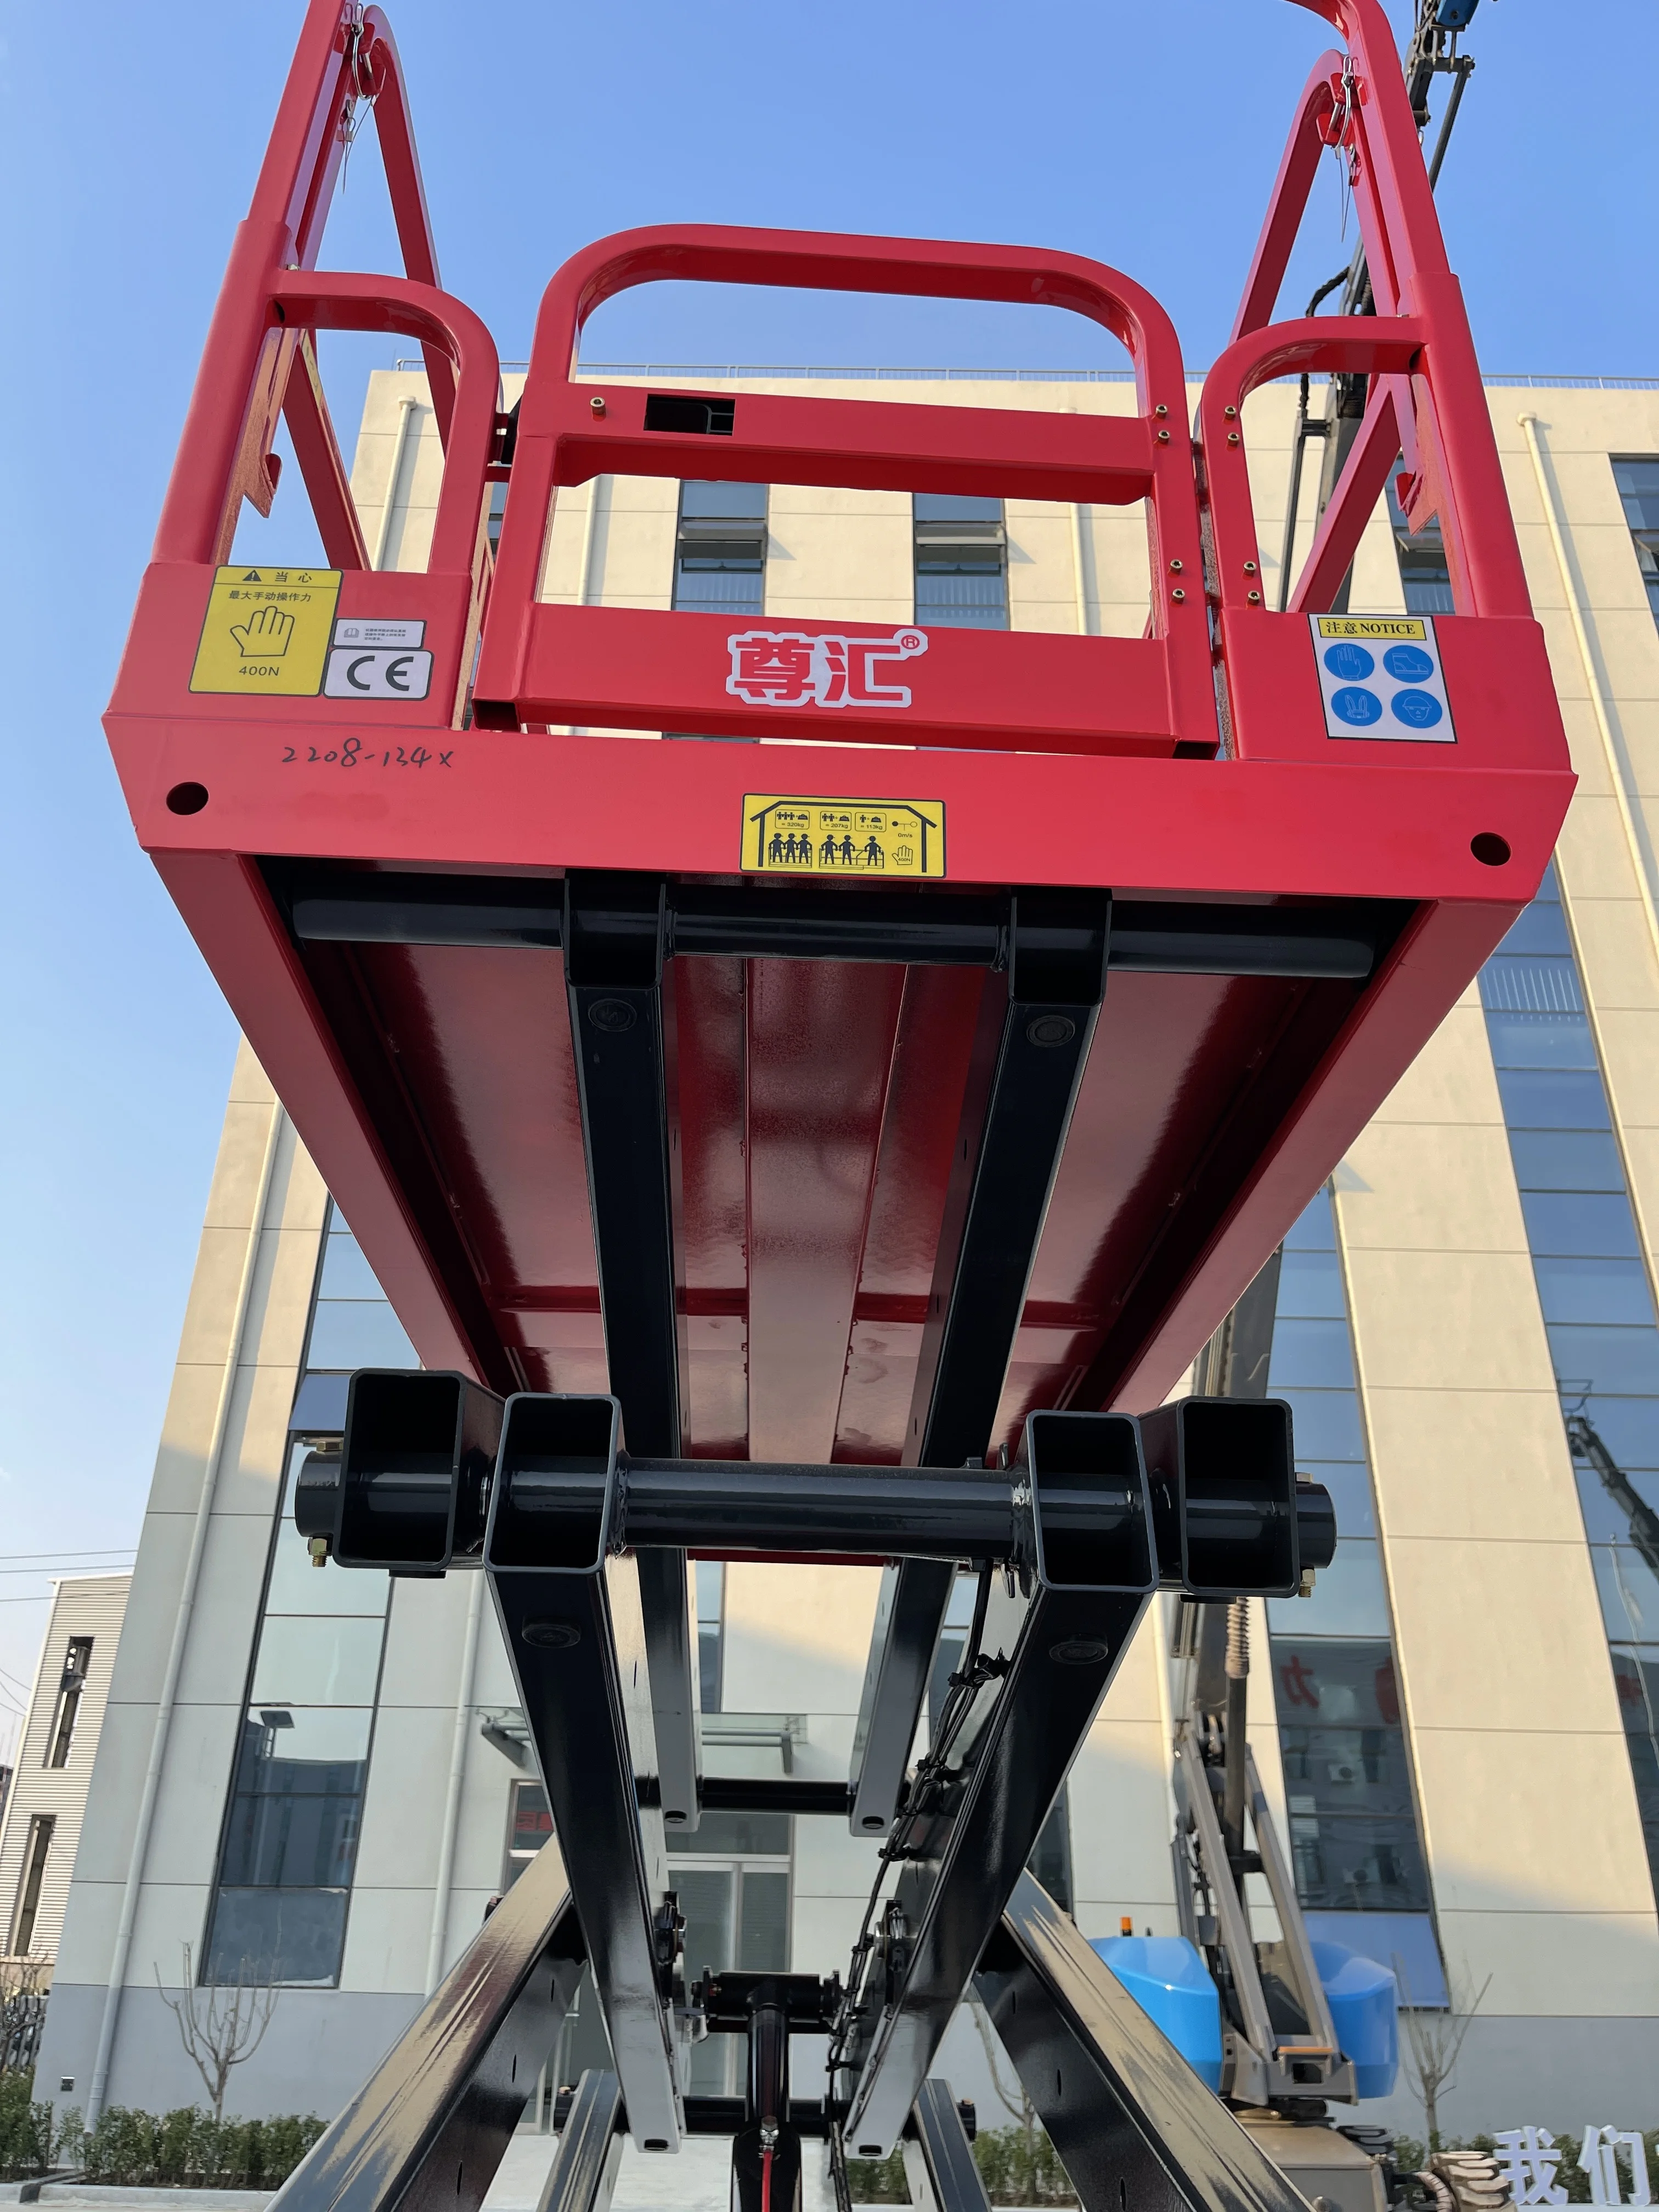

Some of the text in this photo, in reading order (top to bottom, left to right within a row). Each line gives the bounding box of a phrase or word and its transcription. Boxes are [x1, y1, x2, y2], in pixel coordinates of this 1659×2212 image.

[275, 571, 313, 583] 当心
[228, 590, 312, 602] 最大手动操作力
[1325, 621, 1416, 635] 注意 NOTICE
[239, 665, 280, 677] 400N
[346, 654, 414, 692] CE
[733, 637, 904, 702] 尊汇
[1492, 2125, 1659, 2206] 我们
